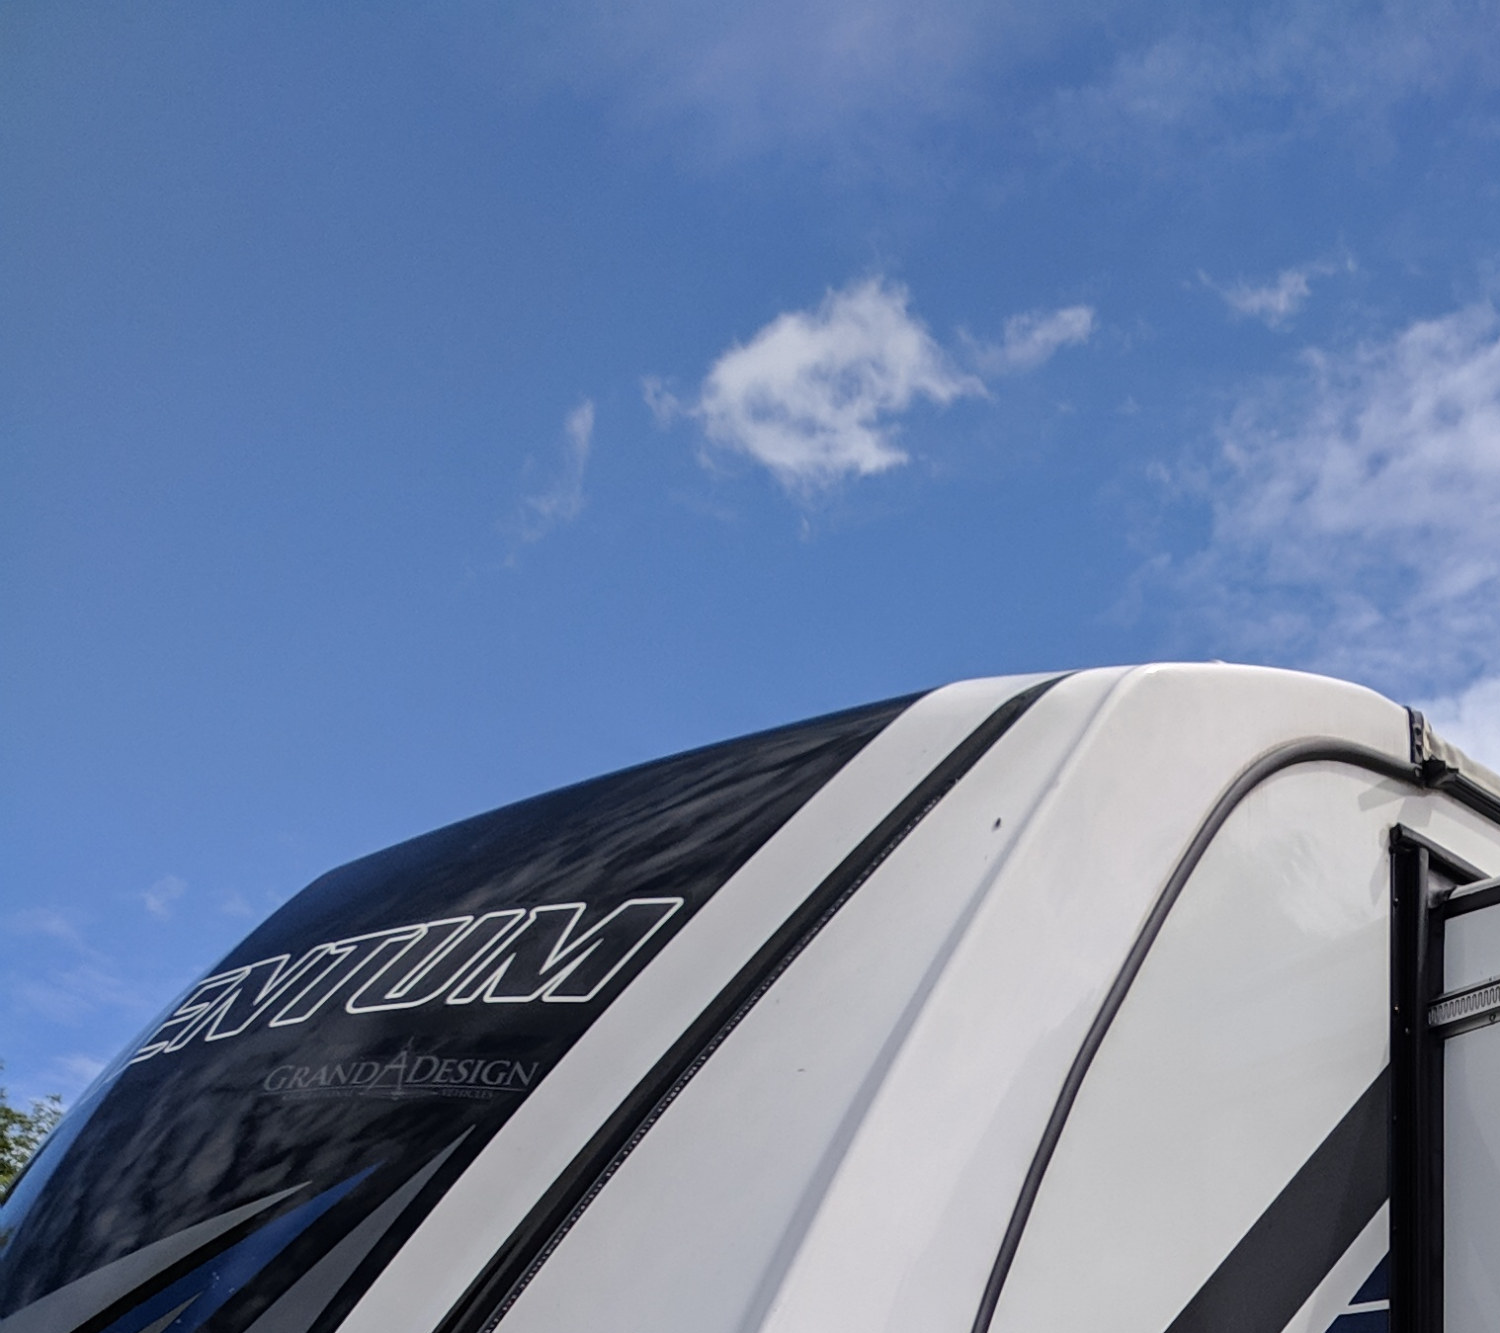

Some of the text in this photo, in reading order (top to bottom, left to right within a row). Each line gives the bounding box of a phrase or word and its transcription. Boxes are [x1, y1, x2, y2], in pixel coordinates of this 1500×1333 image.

[122, 897, 684, 1066] ENTUM
[264, 1054, 540, 1092] GRAND DESIGN
